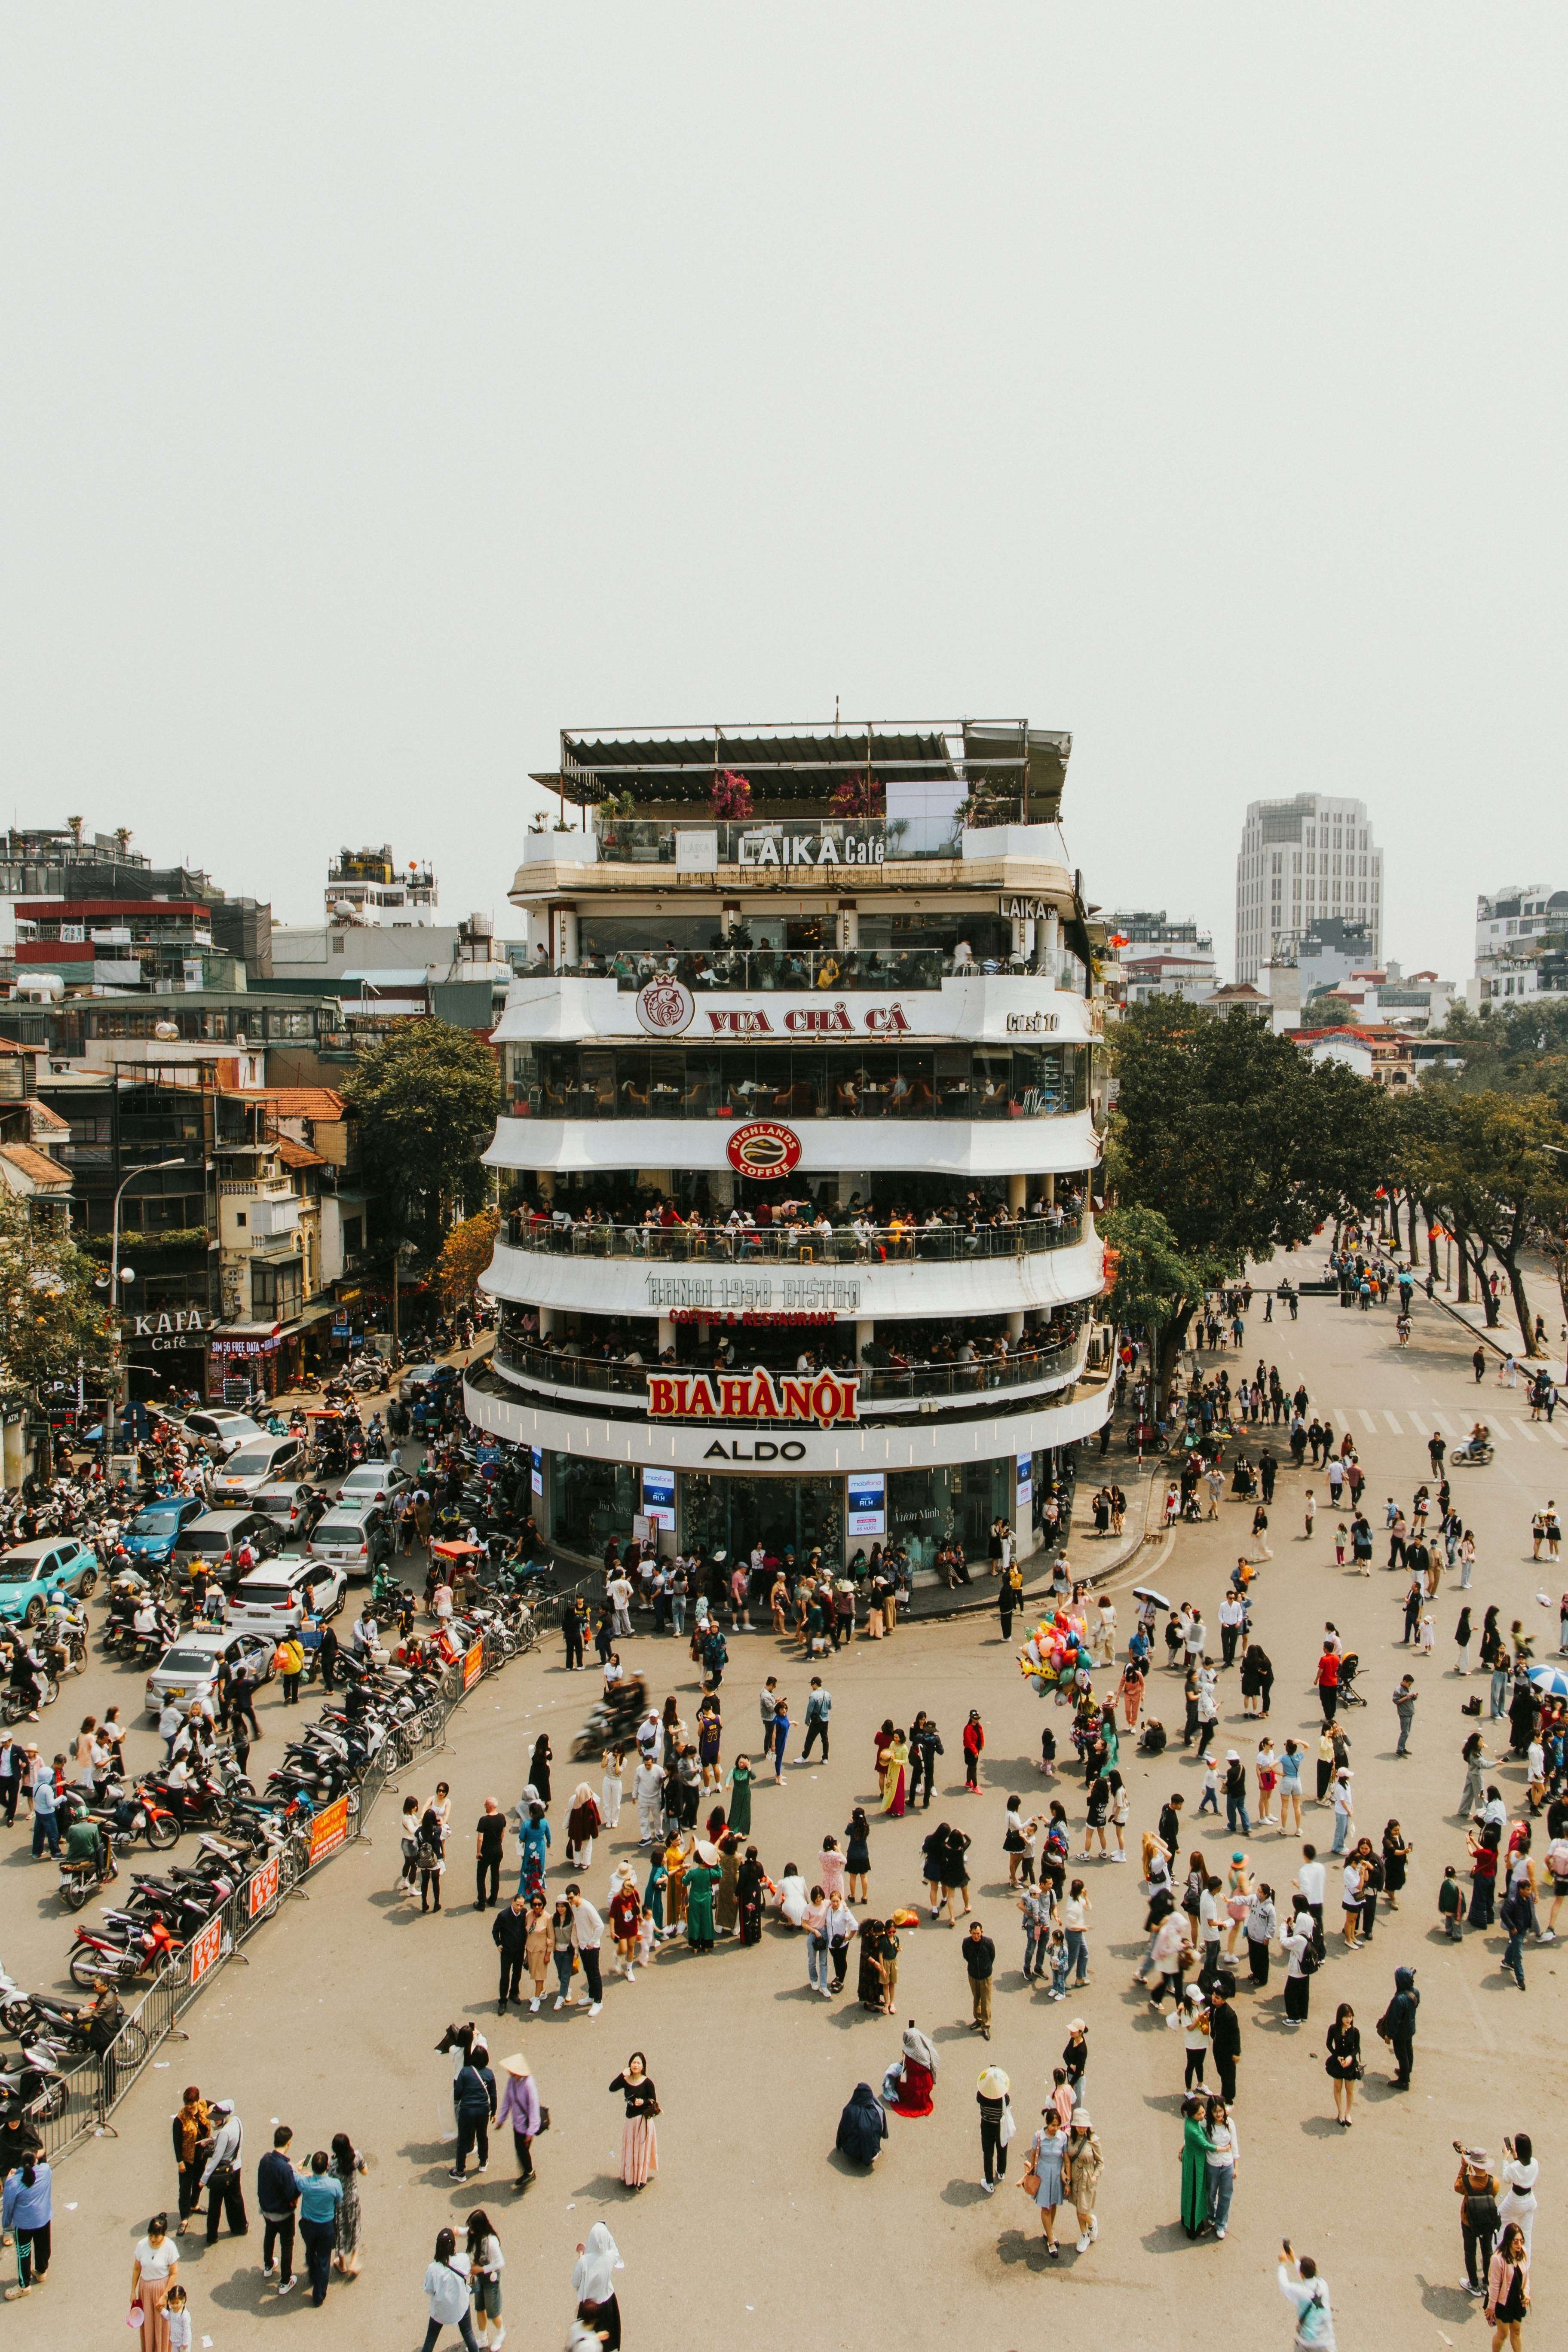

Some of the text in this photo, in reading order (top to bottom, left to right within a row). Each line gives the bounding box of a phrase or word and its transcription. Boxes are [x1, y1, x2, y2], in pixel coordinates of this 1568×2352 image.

[738, 836, 887, 865] LAIKA Café
[1001, 897, 1058, 920] LAIKA Café
[705, 1001, 911, 1032] VUA CHẢ CÁ
[1044, 1013, 1060, 1031] 10
[731, 1126, 796, 1149] HIGHLANDS
[739, 1162, 790, 1176] COFFEE
[647, 1278, 861, 1308] HANOI 1930 BISTRO
[134, 1310, 204, 1336] KAFA
[669, 1310, 838, 1326] COFFEE & RESTAURANT
[151, 1335, 187, 1351] Café
[212, 1341, 222, 1352] SIM
[223, 1341, 231, 1352] 5G
[232, 1341, 245, 1352] FREE
[246, 1341, 260, 1352] DATA
[649, 1371, 858, 1427] BIA HÀ NỘI
[7, 1412, 19, 1423] ATM
[703, 1439, 806, 1461] ALDO
[707, 1729, 718, 1742] 77
